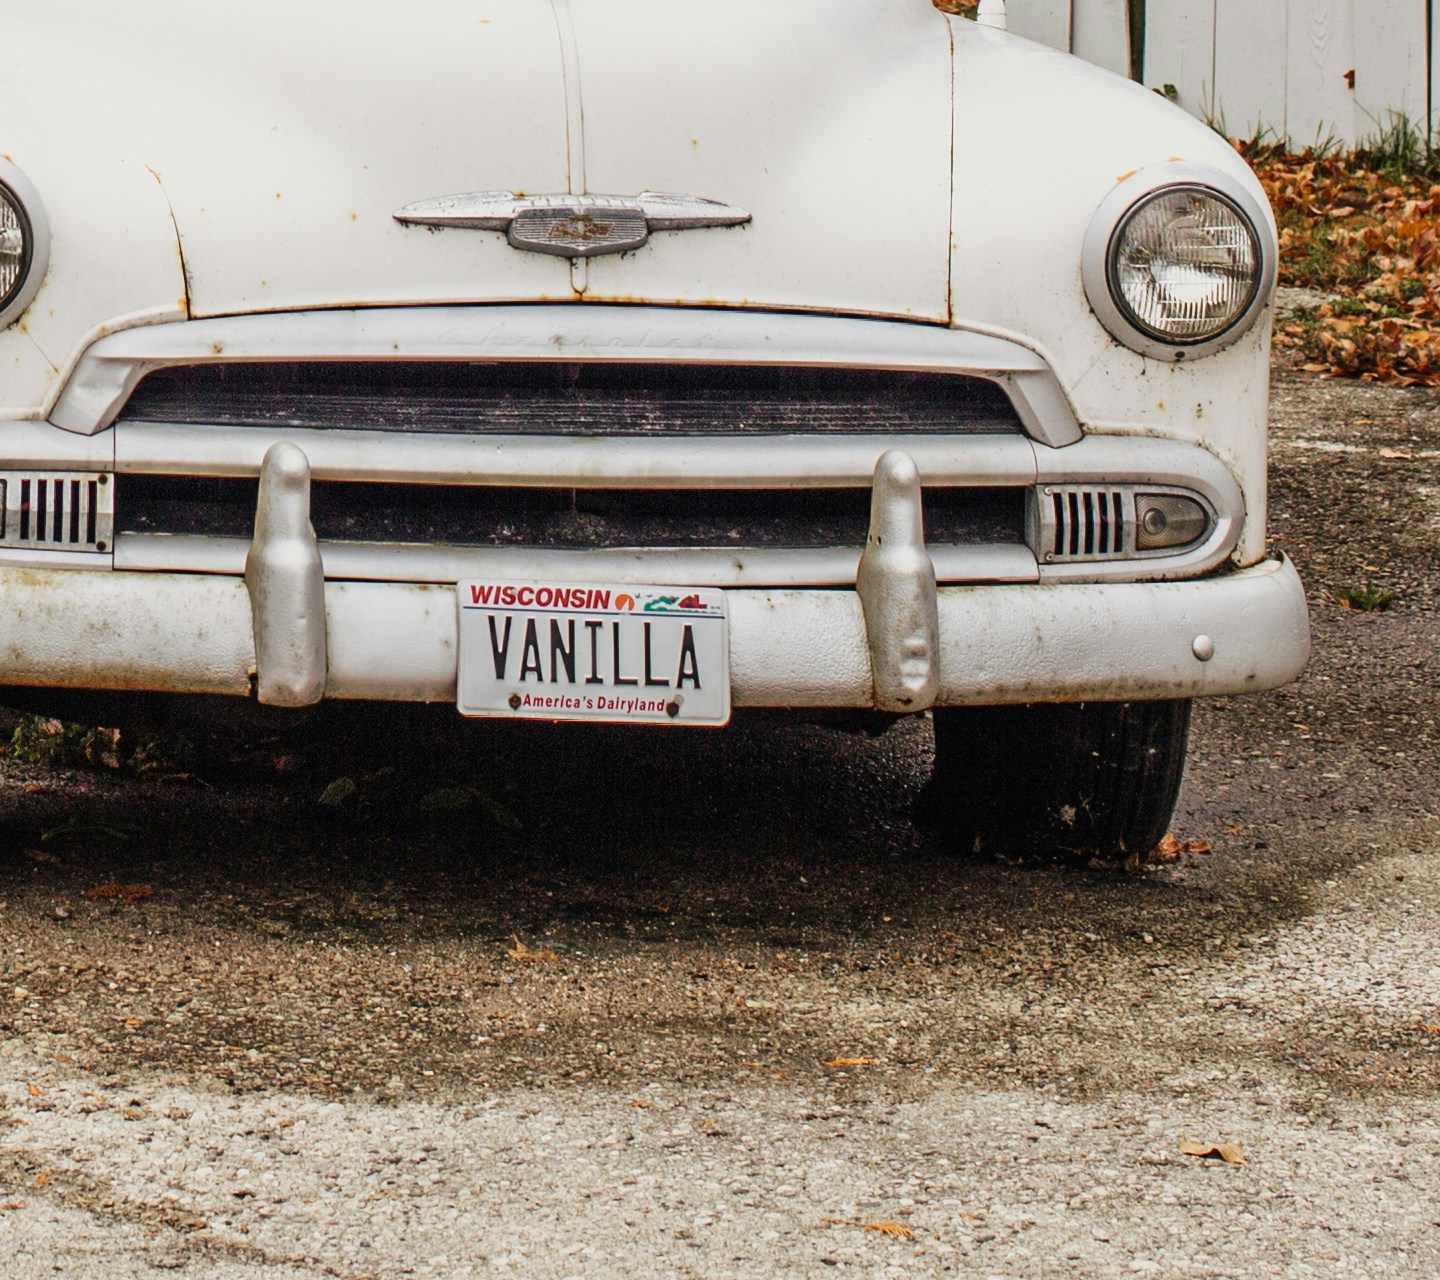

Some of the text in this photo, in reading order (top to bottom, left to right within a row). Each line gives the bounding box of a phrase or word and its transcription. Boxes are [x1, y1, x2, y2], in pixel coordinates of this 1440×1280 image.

[470, 584, 611, 610] WISCONSIN
[487, 614, 702, 690] VANILLA
[522, 693, 665, 714] America's Dairyland
